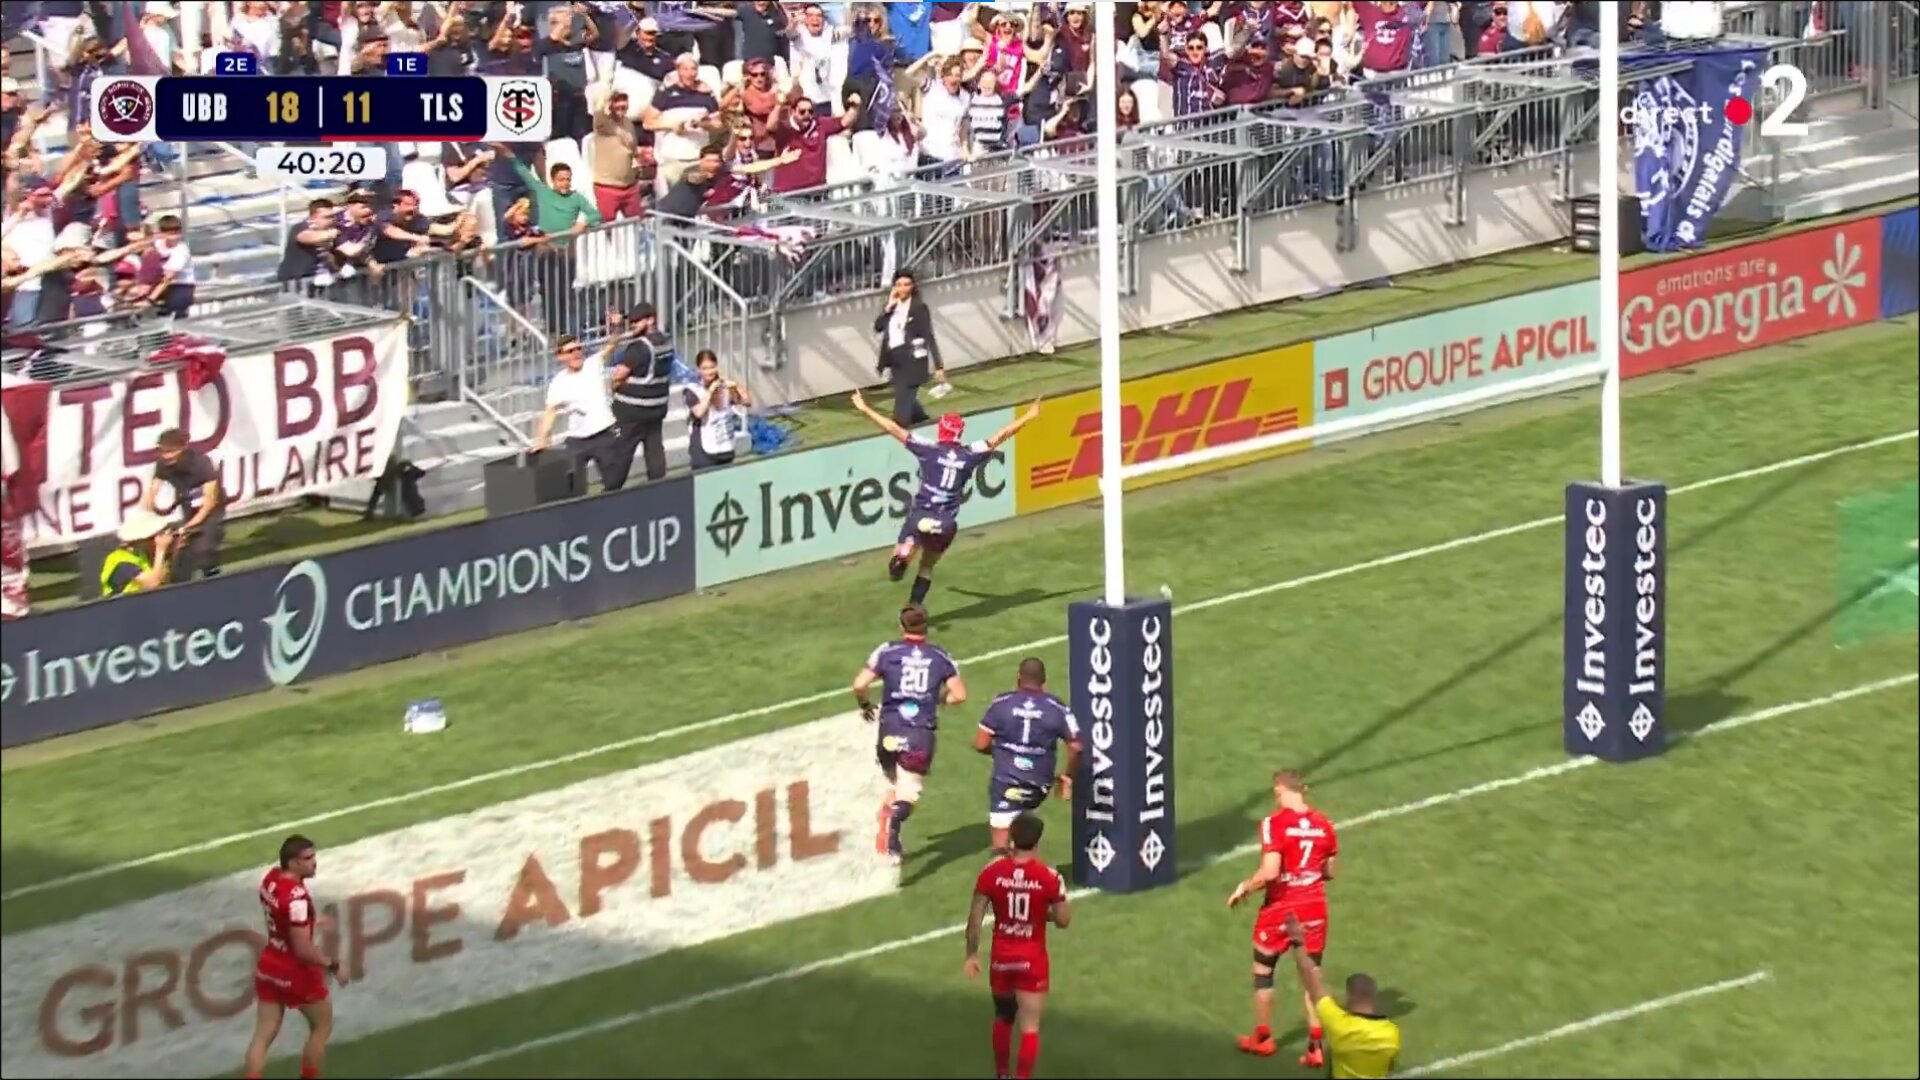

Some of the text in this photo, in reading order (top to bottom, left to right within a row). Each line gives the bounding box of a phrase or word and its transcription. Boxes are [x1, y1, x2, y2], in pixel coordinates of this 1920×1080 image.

[1620, 261, 1806, 355] Georgia
[1656, 258, 1766, 296] emotions are
[273, 336, 379, 440] BB
[1362, 315, 1597, 400] GROUPE APICIL
[1066, 377, 1263, 480] DHL
[940, 467, 957, 490] 11
[24, 516, 681, 705] Investec CHAMPIONS CUP
[1576, 497, 1607, 695] Investec
[1628, 497, 1656, 696] Investec
[900, 665, 929, 693] 20
[1085, 617, 1115, 824] Investec
[1139, 615, 1165, 825] Investec
[1022, 719, 1031, 744] 1
[494, 779, 842, 943] APICIL
[1299, 840, 1314, 868] 7
[1006, 891, 1031, 921] 10
